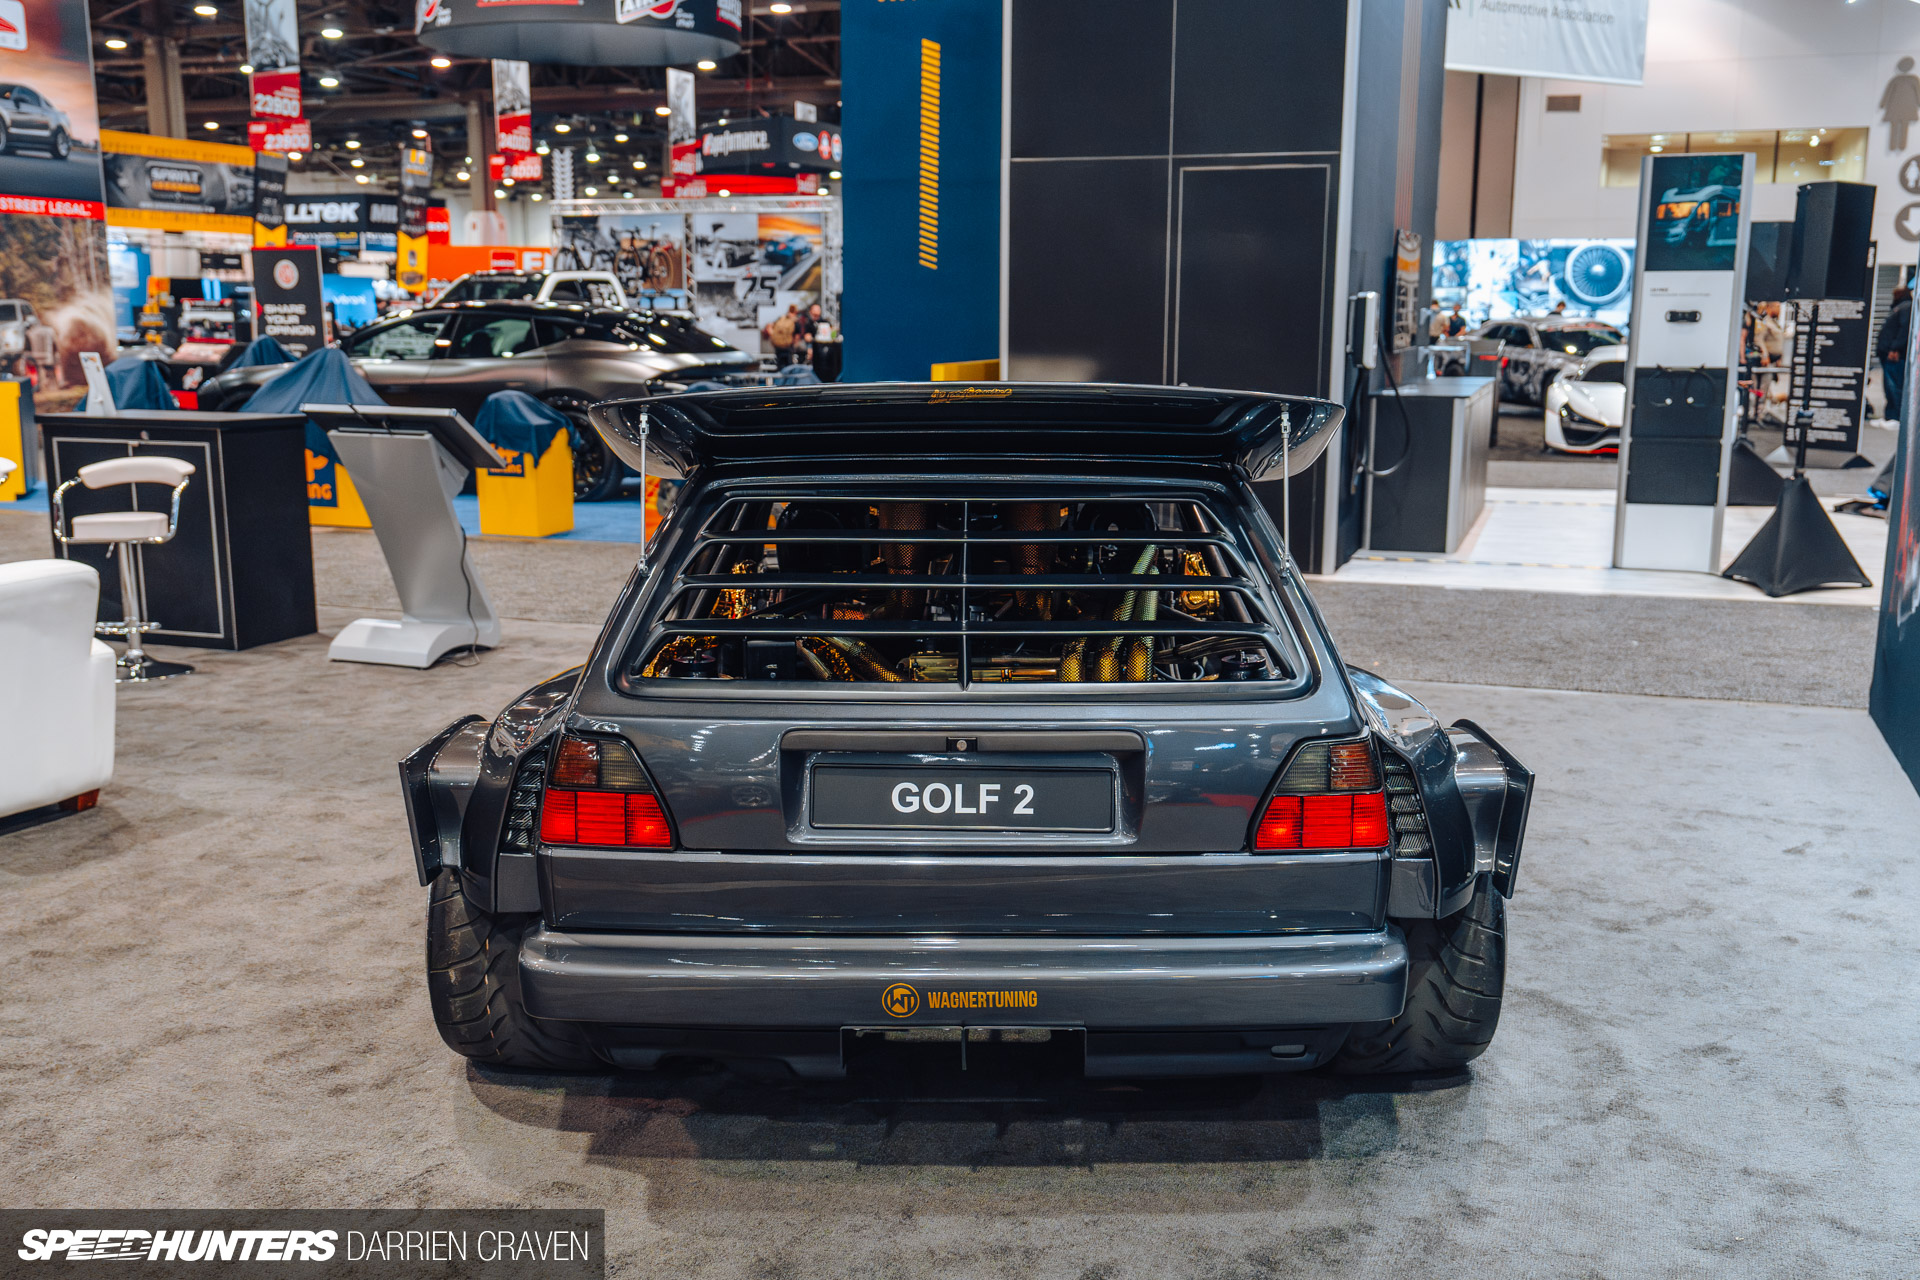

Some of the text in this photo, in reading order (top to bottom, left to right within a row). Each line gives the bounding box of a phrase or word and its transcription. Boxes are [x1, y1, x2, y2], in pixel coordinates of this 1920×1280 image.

[1480, 0, 1615, 25] Automotive Association
[0, 197, 46, 213] STREET
[741, 276, 778, 300] 75
[263, 303, 307, 315] SHARE
[264, 314, 300, 325] YOUR
[265, 325, 316, 337] OPINION
[891, 782, 1035, 815] GOLF 2
[928, 990, 1038, 1009] WAGNERTUNING
